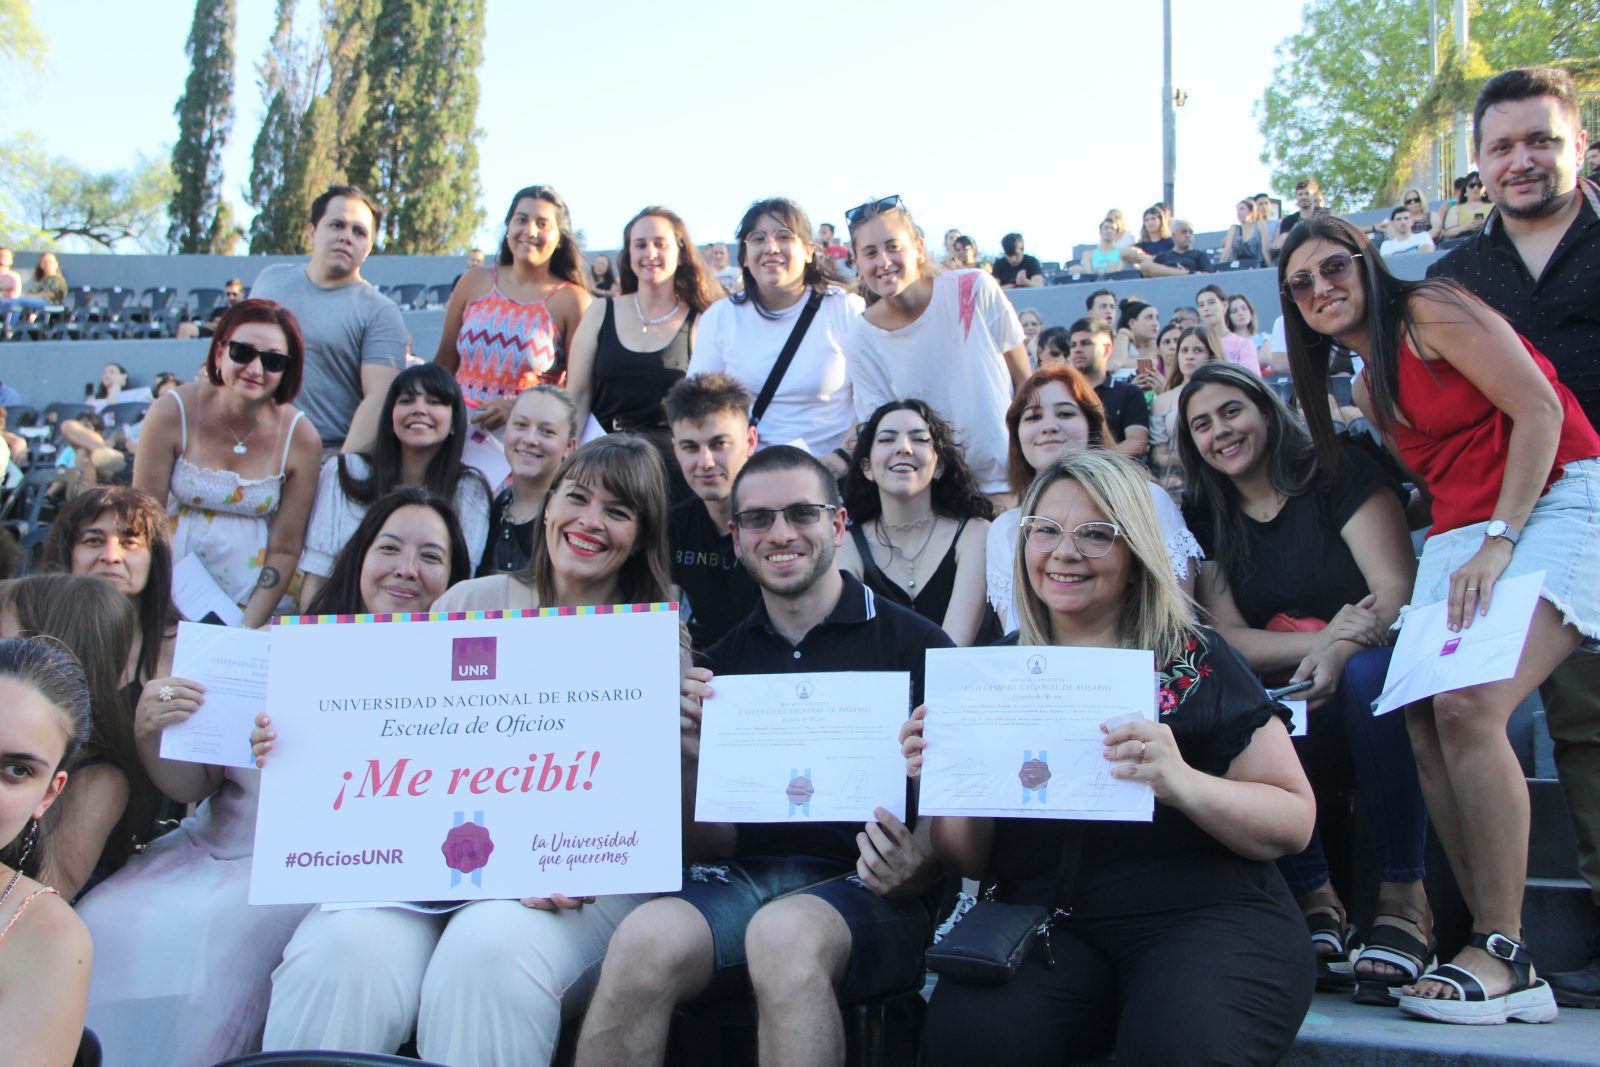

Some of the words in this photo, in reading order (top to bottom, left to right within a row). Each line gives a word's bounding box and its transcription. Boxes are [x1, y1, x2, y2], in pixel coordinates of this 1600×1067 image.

[458, 664, 489, 677] UNR
[319, 696, 437, 712] UNIVERSIDAD
[443, 693, 532, 708] NACIONAL
[539, 692, 560, 704] DE
[567, 688, 642, 703] ROSARIO
[380, 716, 460, 738] Escuela
[465, 715, 489, 734] de
[496, 714, 566, 739] Oficios
[332, 757, 434, 811] ¡Me
[447, 750, 602, 797] recibí!
[531, 833, 548, 852] la
[551, 830, 639, 852] Universidad
[284, 848, 404, 868] #OficiosUNR
[538, 853, 563, 872] que
[566, 851, 631, 871] queremos
